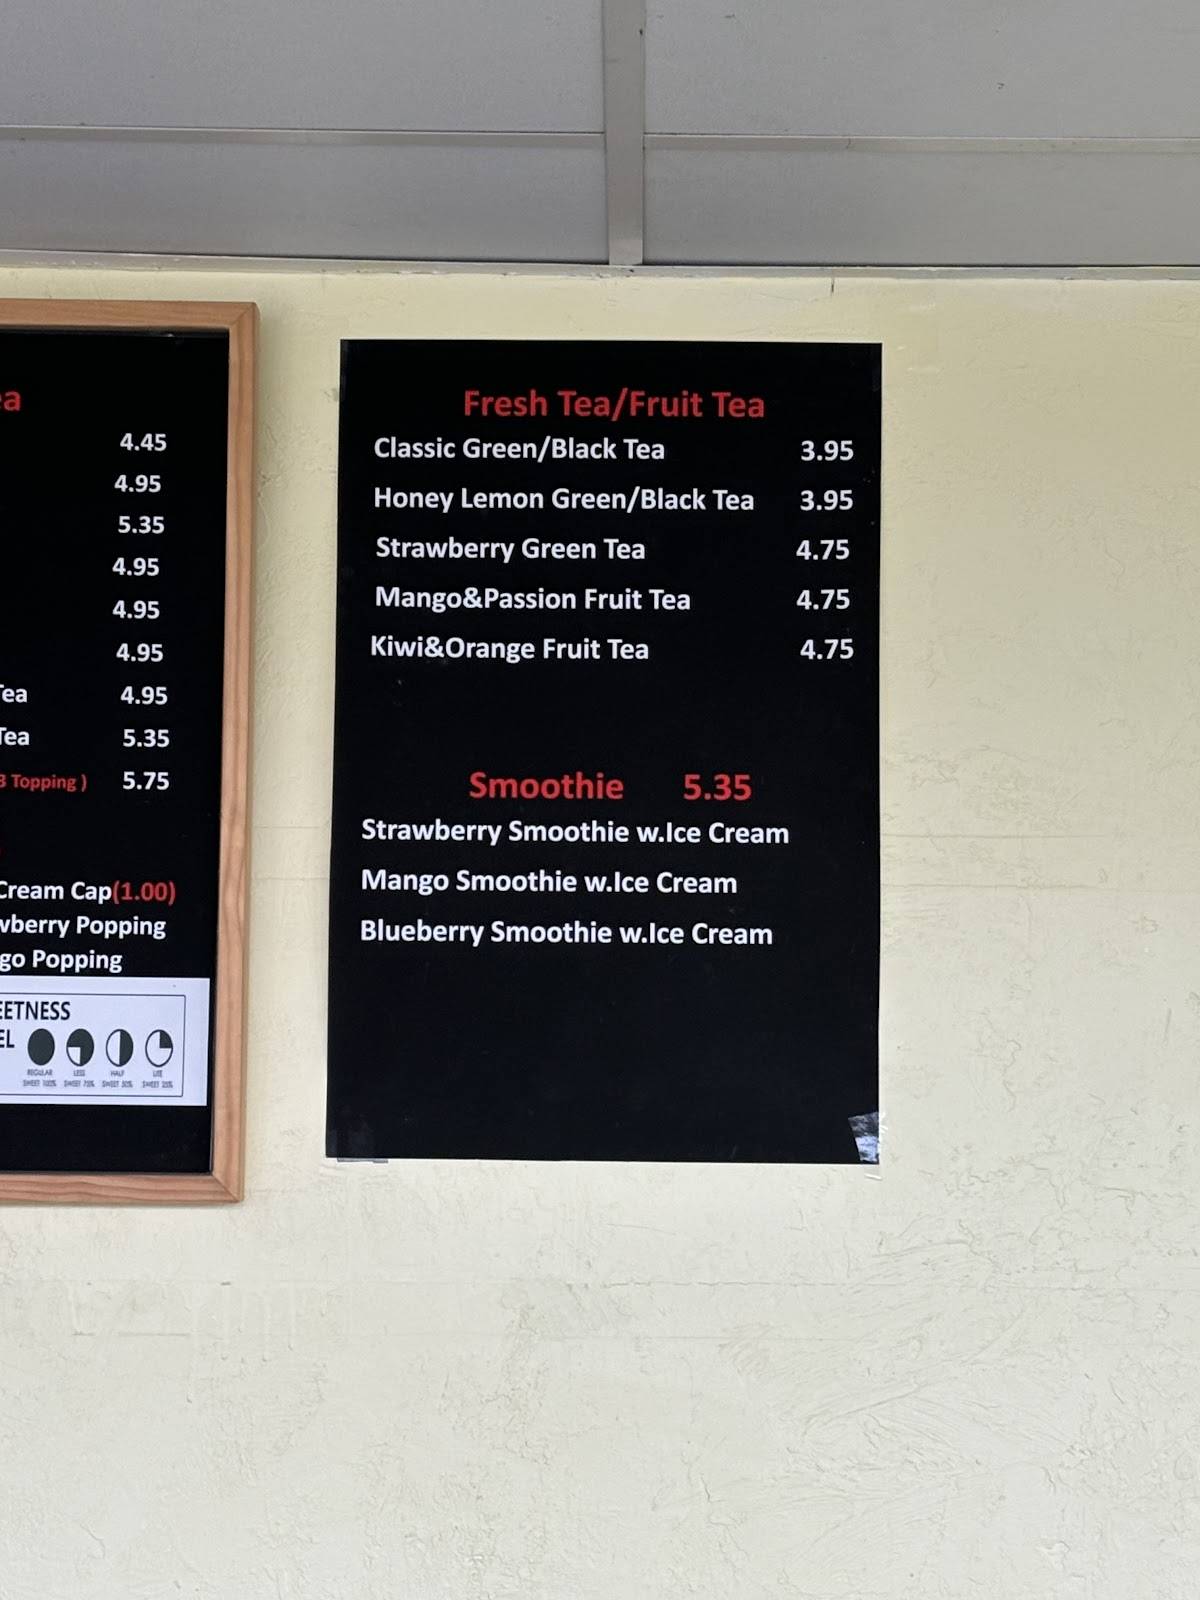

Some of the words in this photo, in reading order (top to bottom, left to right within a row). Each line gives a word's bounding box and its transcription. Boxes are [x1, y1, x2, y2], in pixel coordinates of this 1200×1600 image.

[0, 391, 21, 411] a
[464, 389, 547, 417] Fresh
[558, 387, 702, 421] Tea/Fruit
[711, 392, 764, 418] Tea
[119, 432, 167, 452] 4.45
[374, 436, 456, 459] Classic
[462, 435, 617, 463] Green/Black
[622, 438, 665, 460] Tea
[801, 440, 854, 462] 3.95
[114, 474, 162, 493] 4.95
[374, 486, 454, 514] Honey
[461, 487, 544, 509] Lemon
[551, 485, 706, 514] Green/Black
[712, 489, 754, 511] Tea
[800, 489, 854, 511] 3.95
[118, 515, 165, 535] 5.35
[376, 536, 515, 564] Strawberry
[521, 537, 597, 560] Green
[603, 538, 646, 560] Tea
[795, 539, 850, 561] 4.75
[112, 557, 160, 577] 4.95
[112, 599, 160, 620] 4.95
[375, 586, 577, 614] Mango&Passion
[584, 587, 643, 610] Fruit
[648, 588, 691, 611] Tea
[796, 588, 850, 610] 4.75
[116, 642, 164, 663] 4.95
[371, 634, 536, 664] Kiwi&Orange
[543, 637, 601, 660] Fruit
[606, 638, 649, 660] Tea
[800, 638, 854, 660] 4.75
[120, 685, 168, 706] 4.95
[122, 728, 170, 748] 5.35
[11, 774, 76, 792] Topping
[122, 771, 170, 791] 5.75
[470, 771, 624, 800] Smoothie
[684, 774, 752, 801] 5.35
[361, 818, 503, 847] Strawberry
[508, 819, 630, 843] Smoothie
[636, 821, 702, 844] w.Ice
[708, 821, 789, 844] Cream
[361, 868, 450, 896] Mango
[455, 869, 578, 893] Smoothie
[583, 871, 650, 893] w.Ice
[656, 871, 738, 894] Cream
[76, 915, 167, 940] Popping
[360, 918, 485, 948] Blueberry
[490, 920, 613, 944] Smoothie
[618, 922, 685, 945] w.Ice
[691, 922, 773, 945] Cream
[32, 949, 123, 974] Popping
